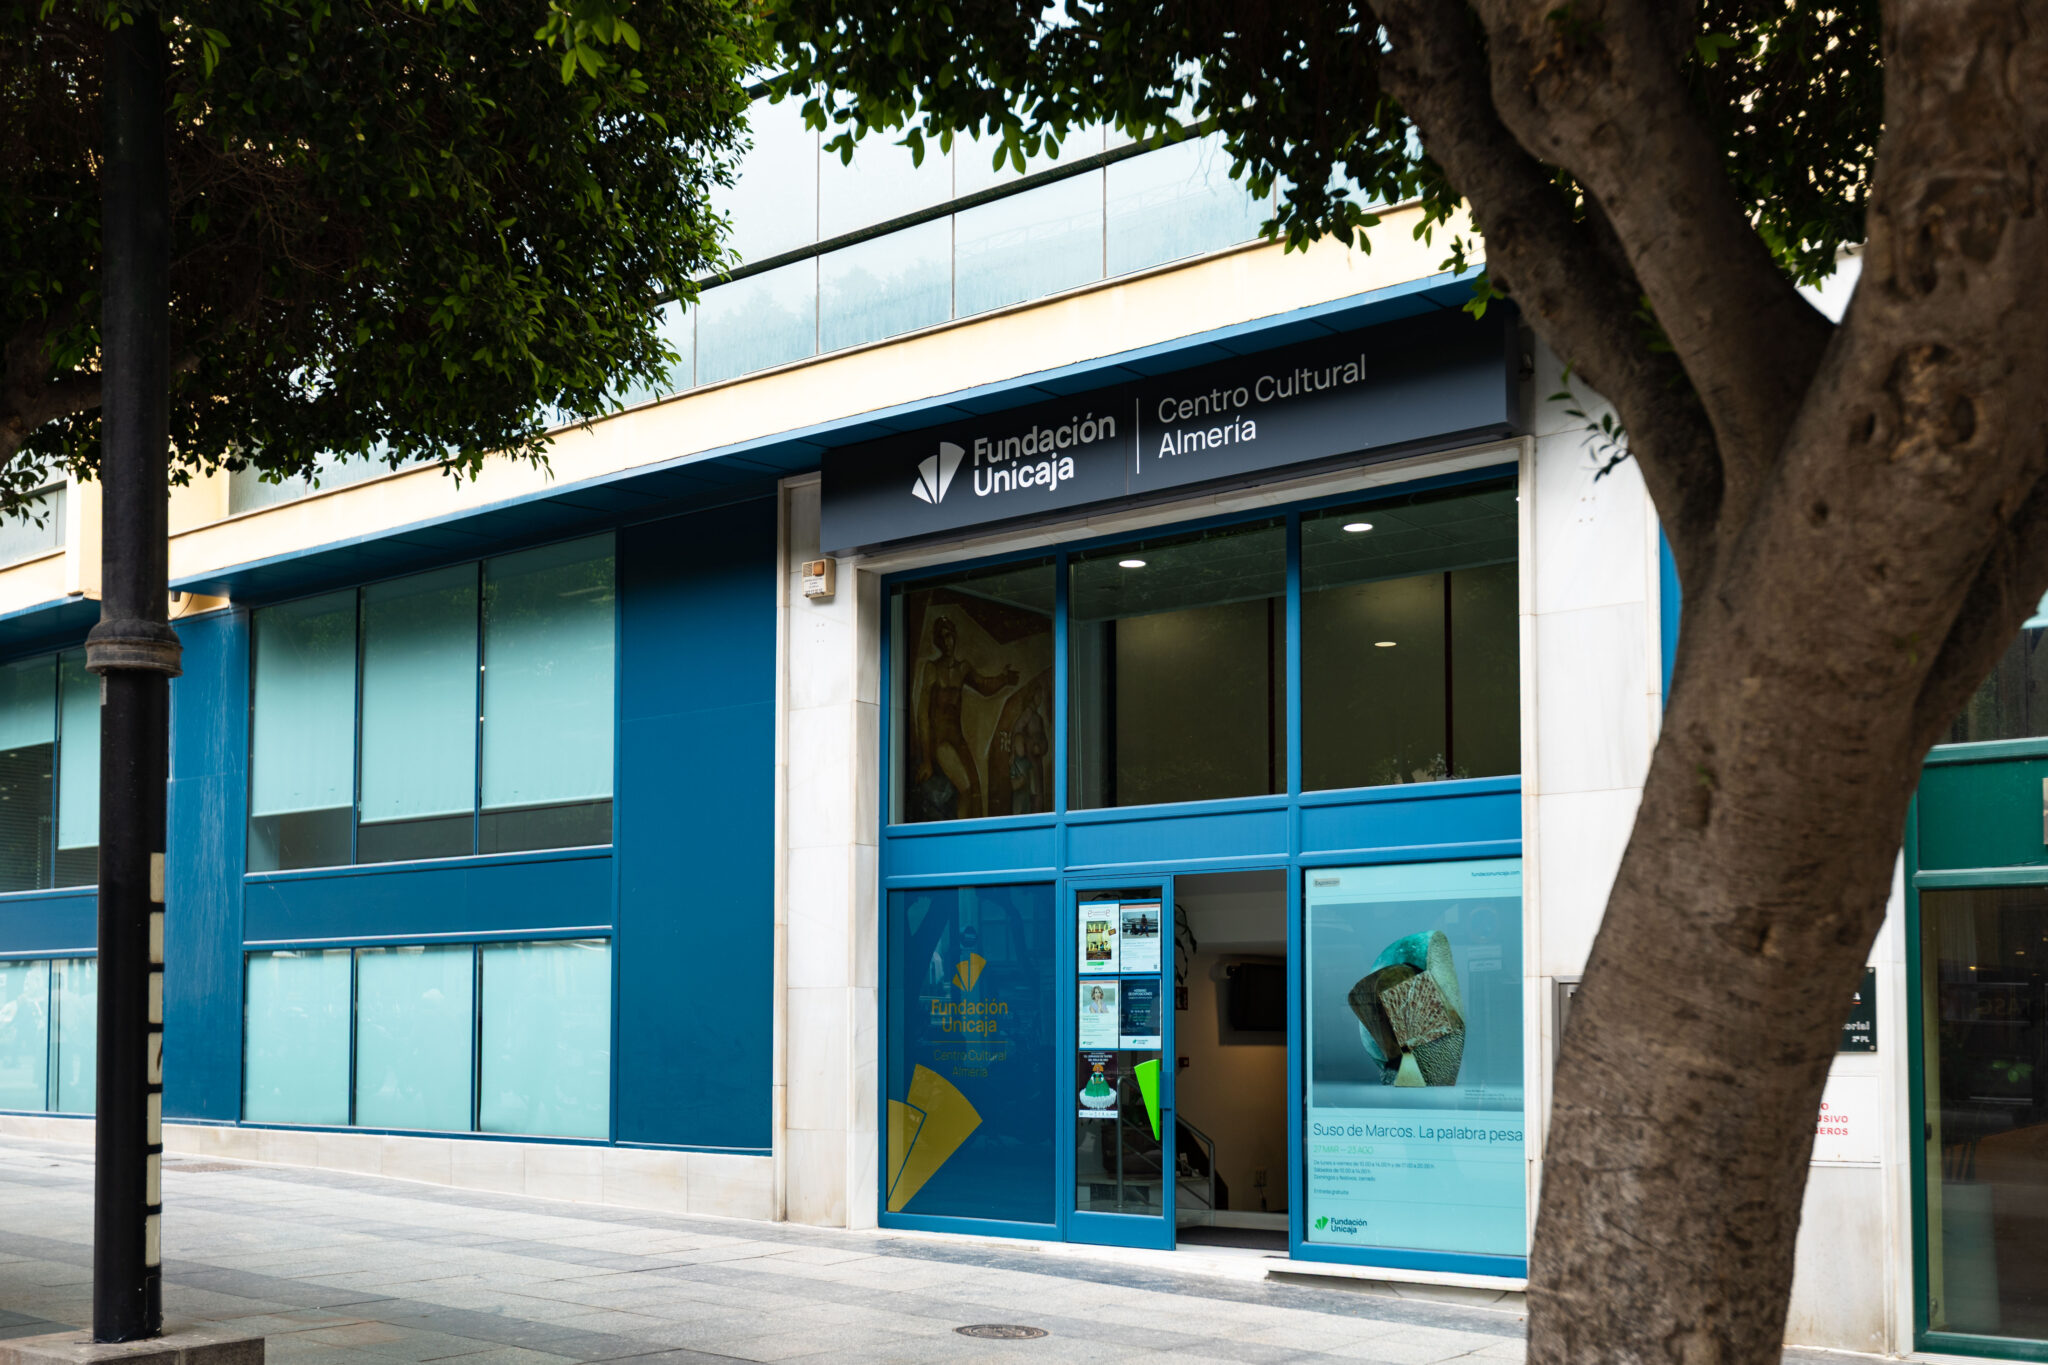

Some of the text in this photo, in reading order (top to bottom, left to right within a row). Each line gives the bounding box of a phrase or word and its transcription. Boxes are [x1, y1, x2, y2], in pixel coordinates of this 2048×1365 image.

[1158, 353, 1366, 423] Centro Cultural
[974, 412, 1116, 466] Fundación
[1158, 415, 1257, 459] Almería
[974, 452, 1075, 497] Unicaja
[931, 998, 1008, 1015] Fundación
[942, 1015, 997, 1037] Unicaja
[934, 1049, 1007, 1061] Centro Cultural
[1313, 1122, 1523, 1144] Suso de Marcos. La palabra pesa
[1331, 1218, 1368, 1227] Fundación
[1331, 1225, 1357, 1235] Unicaja
